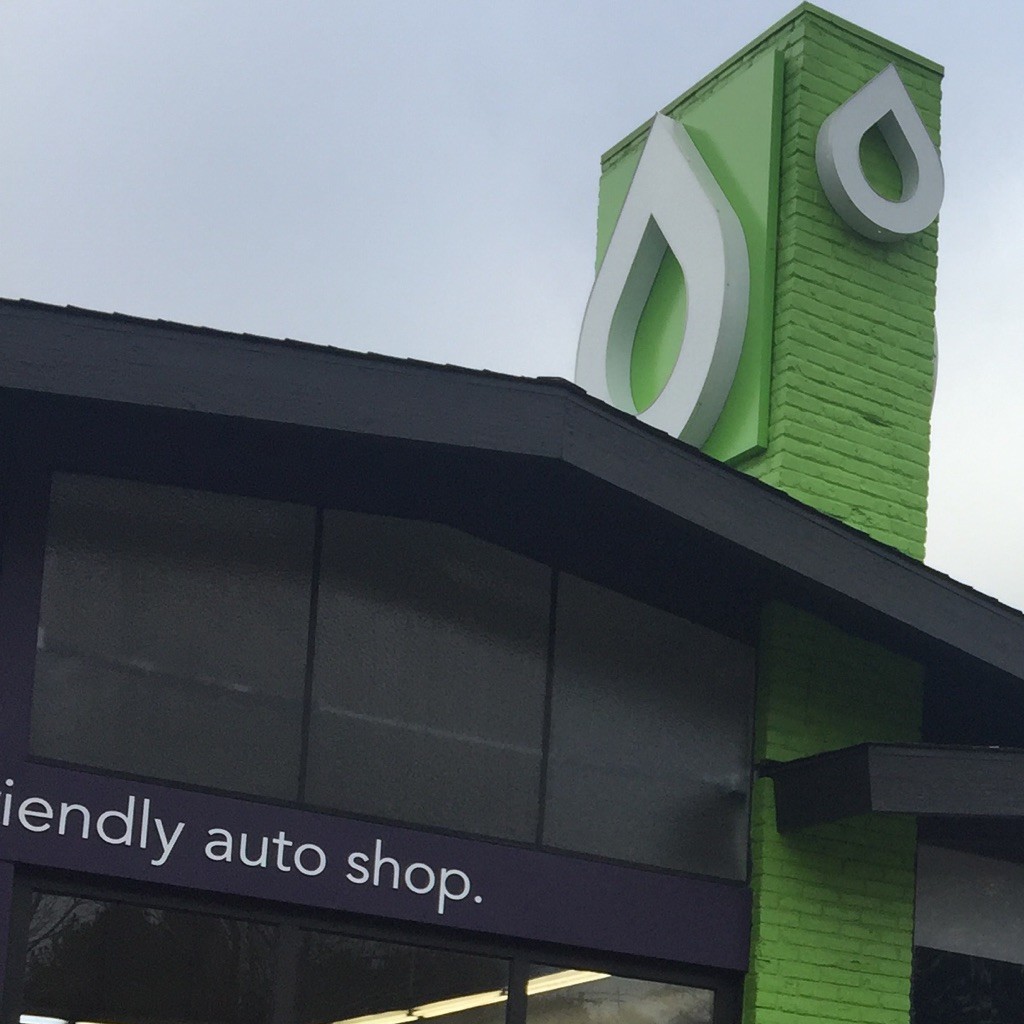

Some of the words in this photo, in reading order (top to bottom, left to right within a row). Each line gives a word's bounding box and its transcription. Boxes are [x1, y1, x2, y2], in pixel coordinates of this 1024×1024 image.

[0, 778, 185, 866] iendly
[204, 827, 327, 876] auto
[345, 838, 483, 915] shop.
